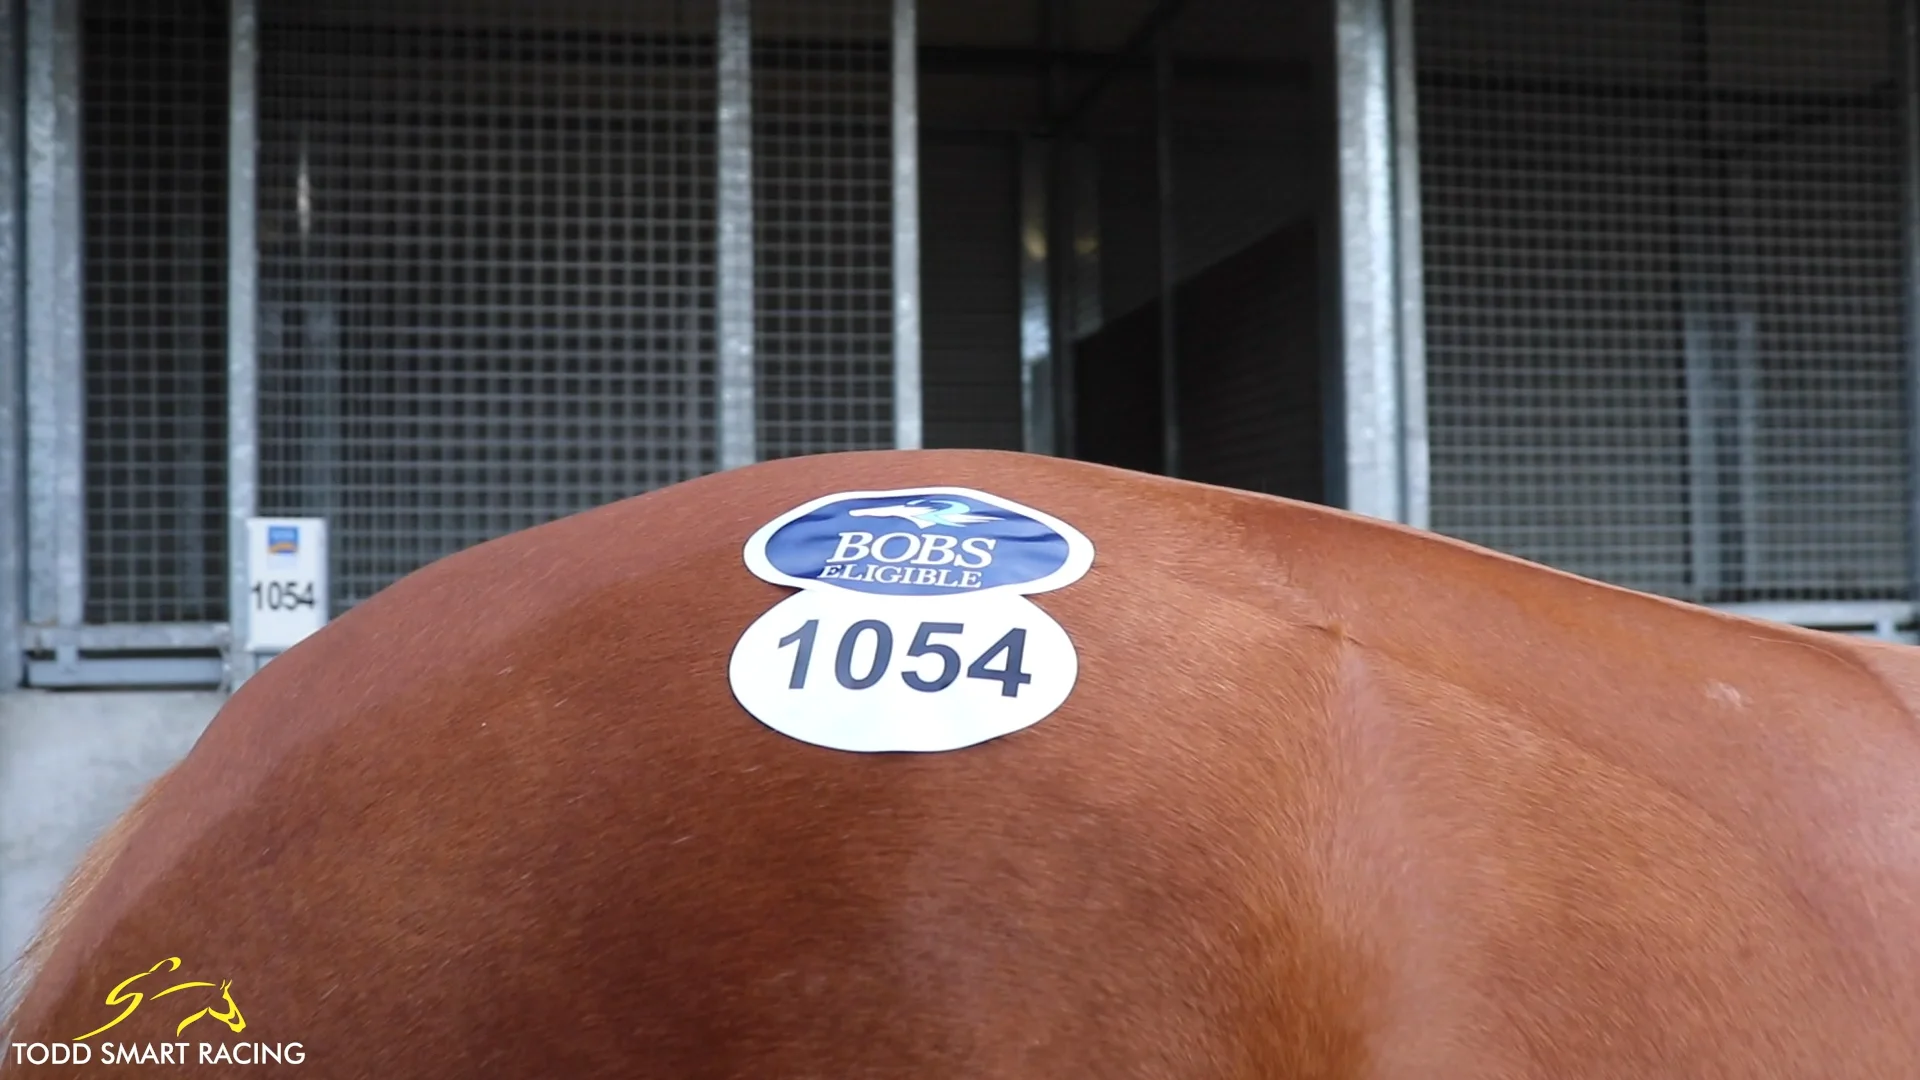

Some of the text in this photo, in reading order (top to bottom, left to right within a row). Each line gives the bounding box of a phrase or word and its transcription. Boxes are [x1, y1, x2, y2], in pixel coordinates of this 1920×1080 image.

[826, 531, 996, 568] BOBS
[817, 564, 982, 589] ELIGIBLE
[252, 581, 315, 610] 1054
[777, 619, 1032, 698] 1054
